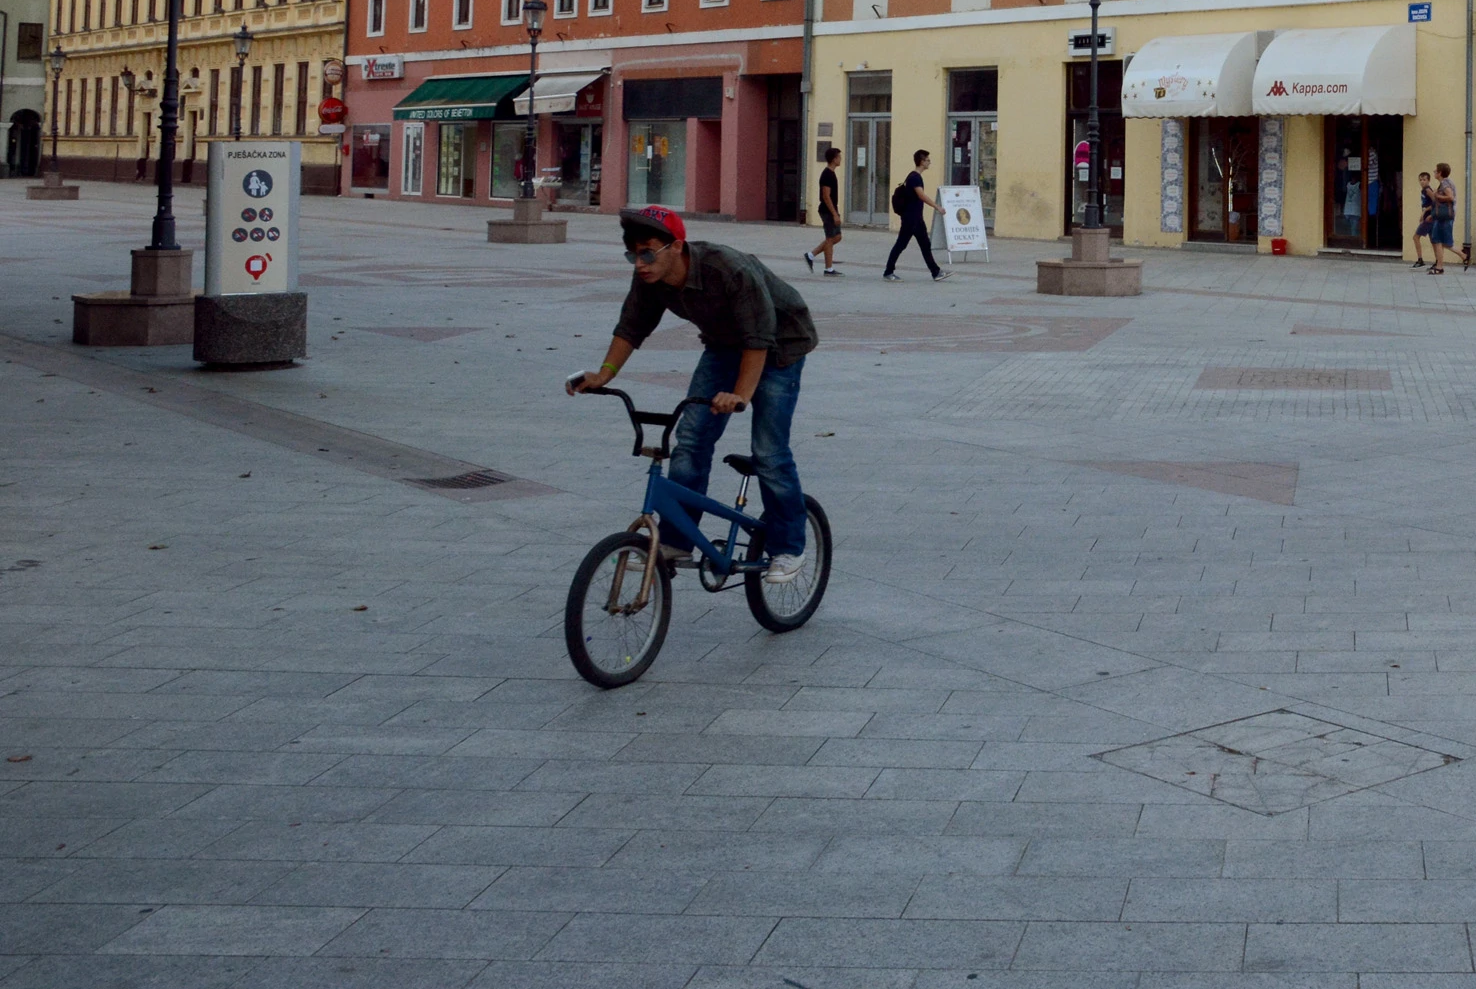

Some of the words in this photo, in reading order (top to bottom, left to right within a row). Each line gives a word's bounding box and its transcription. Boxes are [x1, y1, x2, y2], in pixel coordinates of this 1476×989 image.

[1292, 82, 1348, 96] Kappa.com
[444, 109, 450, 118] OF
[227, 150, 267, 159] PJEŠAČKA
[268, 151, 286, 159] ZONA
